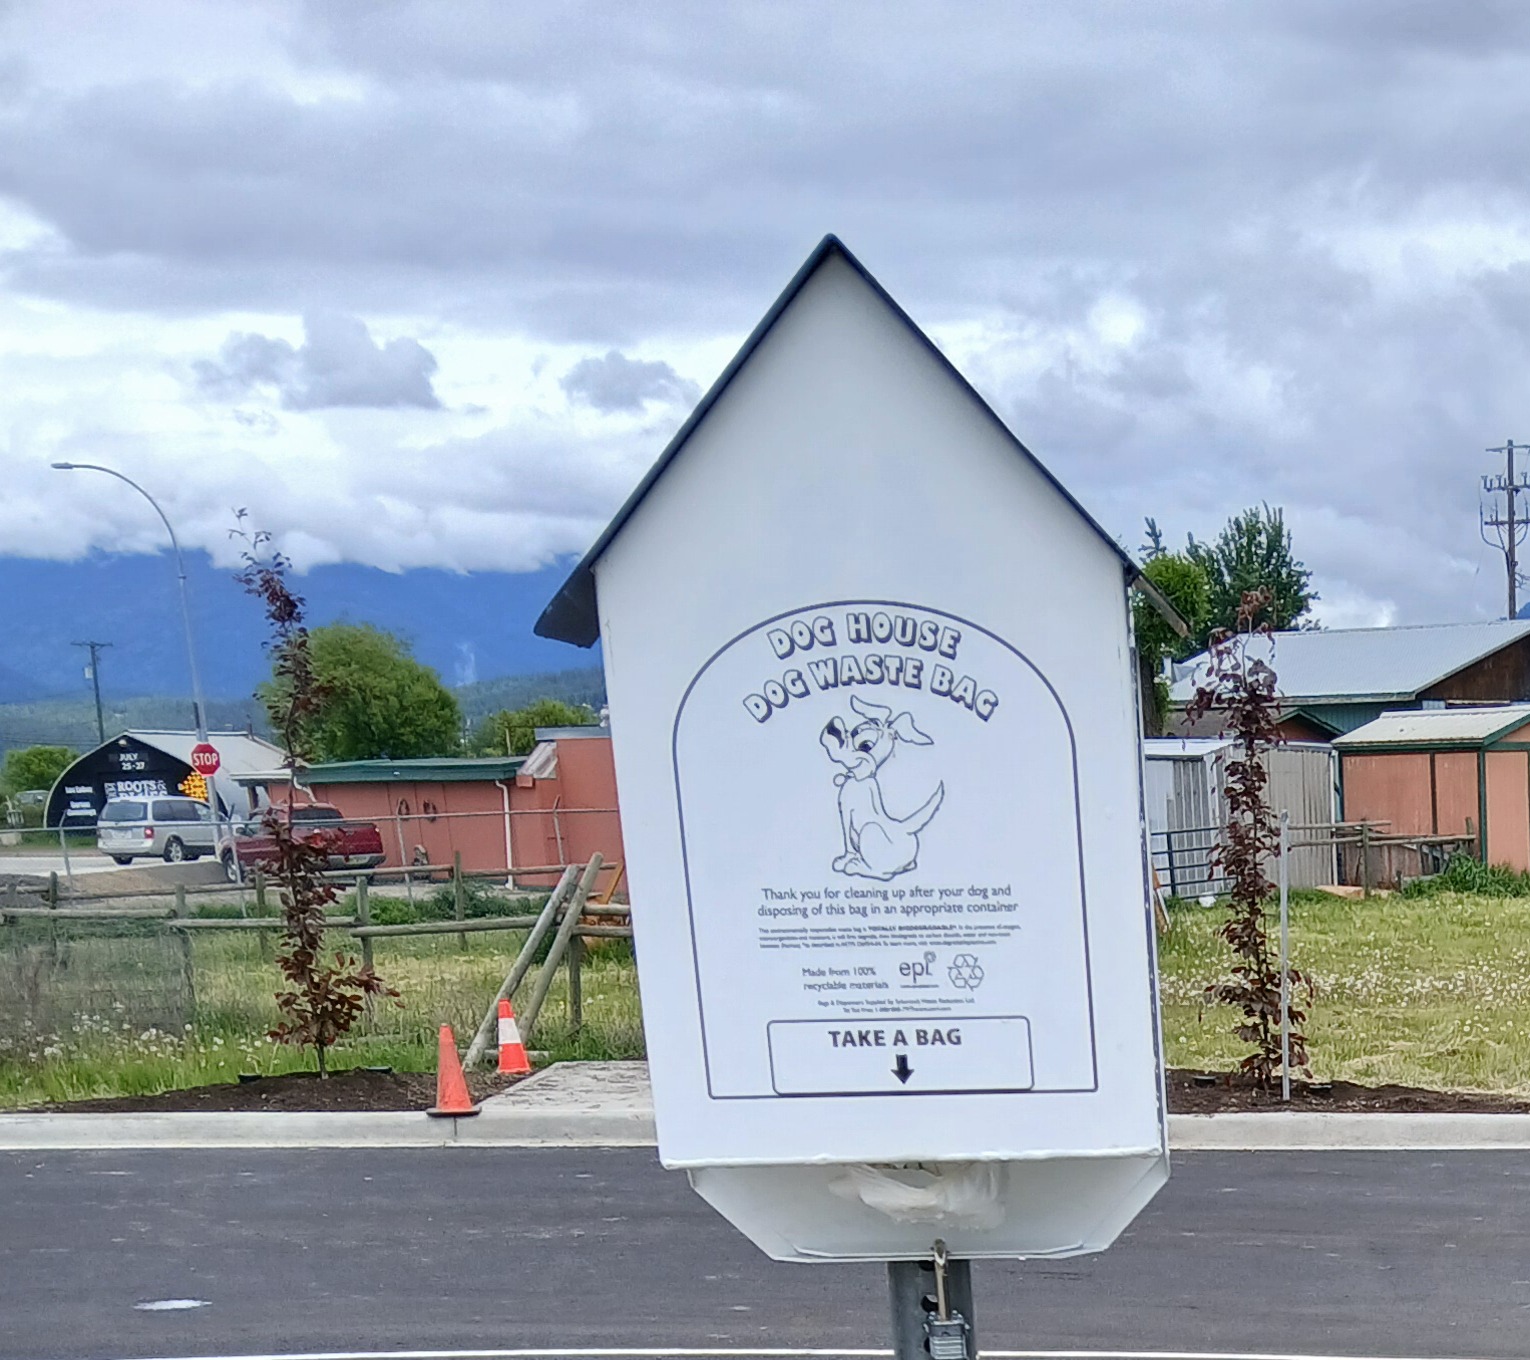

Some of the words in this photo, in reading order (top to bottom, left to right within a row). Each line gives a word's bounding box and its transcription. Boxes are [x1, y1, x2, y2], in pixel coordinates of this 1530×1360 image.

[767, 616, 836, 659] DOG
[846, 612, 961, 660] HOUSE
[743, 670, 810, 723] DOG
[807, 654, 924, 691] WASTE
[930, 663, 999, 722] BAG
[193, 753, 218, 766] STOP
[117, 780, 157, 794] ROOTS
[761, 888, 797, 900] Thank
[800, 890, 820, 902] you
[824, 887, 841, 899] for
[844, 887, 889, 901] cleaning
[892, 889, 906, 901] up
[909, 885, 934, 898] after
[938, 888, 964, 900] your
[968, 885, 988, 899] dog
[991, 885, 1011, 896] and
[757, 904, 808, 919] disposing
[811, 903, 823, 915] of
[825, 904, 845, 915] this
[848, 904, 868, 918] bag
[870, 903, 881, 914] in
[884, 905, 897, 914] an
[900, 902, 964, 917] appropriate
[967, 901, 1019, 912] container
[802, 967, 826, 977] Made
[828, 967, 850, 977] from
[853, 966, 877, 976] 100%
[803, 982, 847, 992] recyclable
[828, 1029, 886, 1049] TAKE
[893, 1029, 909, 1047] A
[916, 1028, 962, 1046] BAG
